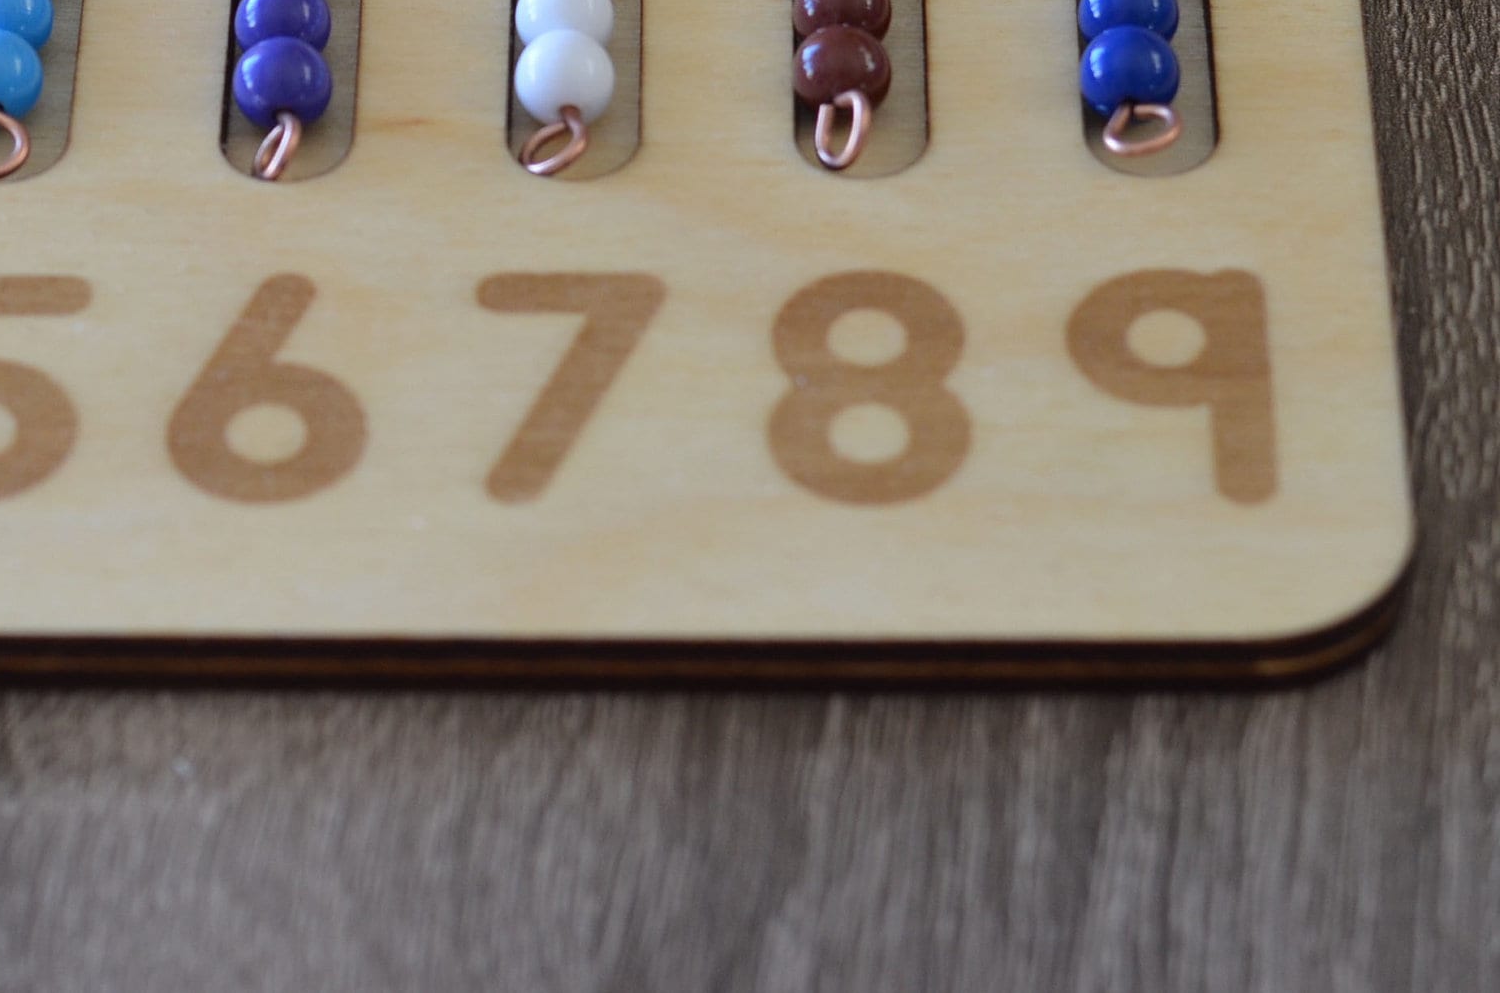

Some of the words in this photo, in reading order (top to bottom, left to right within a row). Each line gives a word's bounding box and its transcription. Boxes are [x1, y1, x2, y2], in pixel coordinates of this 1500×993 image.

[163, 272, 368, 505] 6
[473, 270, 669, 503] 7
[764, 268, 974, 508] 8
[1059, 267, 1280, 508] 9
